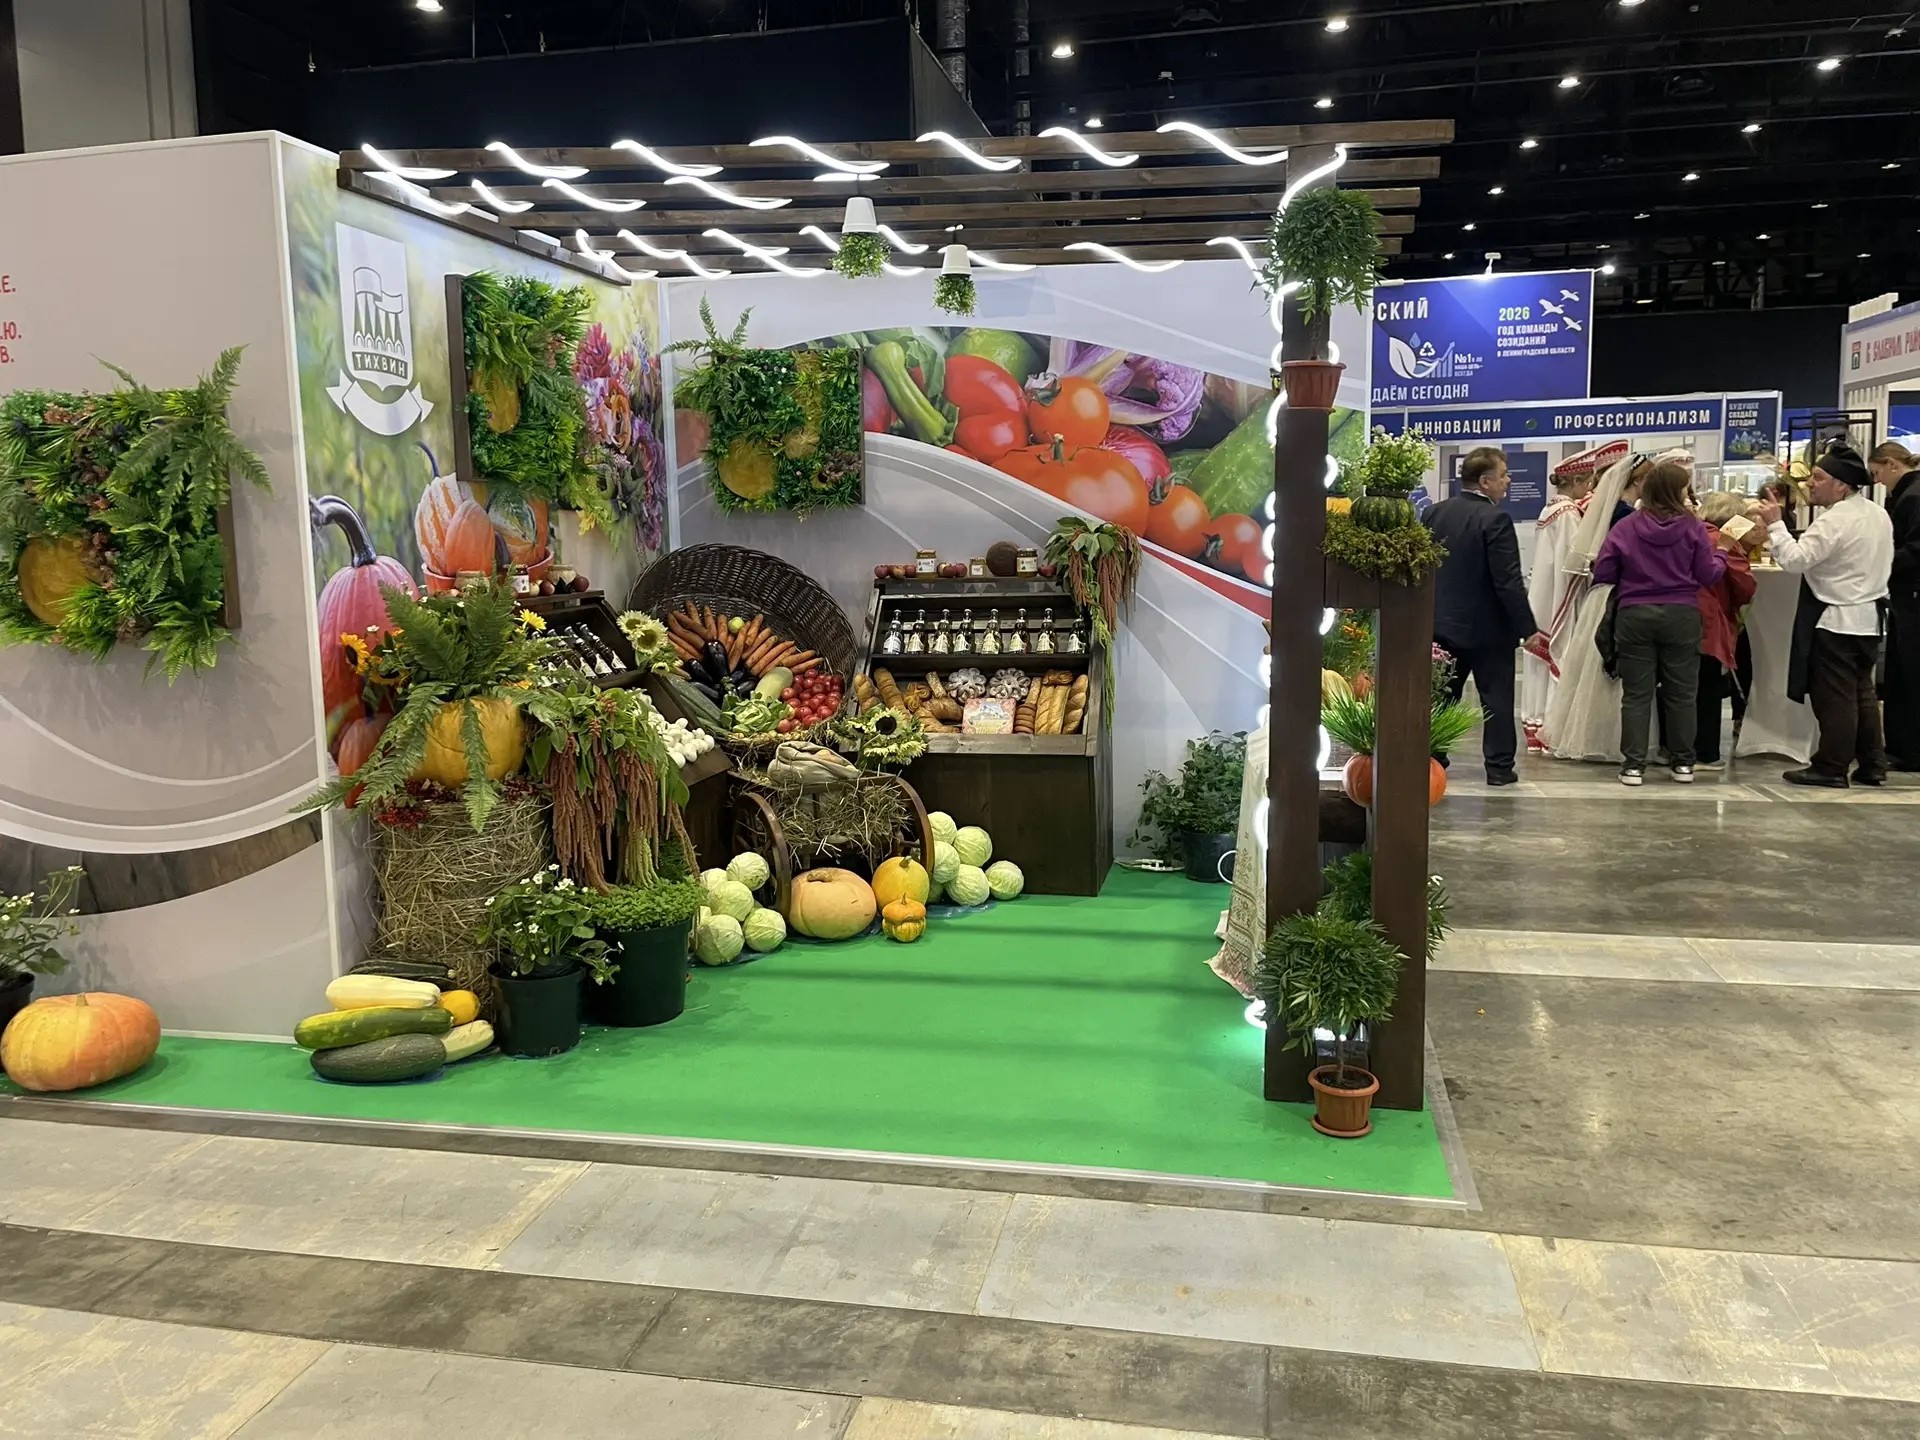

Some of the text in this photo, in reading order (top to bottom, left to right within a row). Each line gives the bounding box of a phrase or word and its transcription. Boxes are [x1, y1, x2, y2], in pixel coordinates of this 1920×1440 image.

[1373, 297, 1428, 321] СКИЙ
[1499, 307, 1530, 321] 2026
[1497, 323, 1558, 336] ГОД КОМАНДЫ
[1497, 336, 1546, 347] СОЗИДАНИЯ
[355, 354, 405, 377] ТИХВИН
[1454, 353, 1471, 364] №1
[1411, 384, 1469, 400] СЕГОДНЯ
[1415, 409, 1710, 435] ИННОВАЦИИ ПРОФЕССИОНАЛИЗМ
